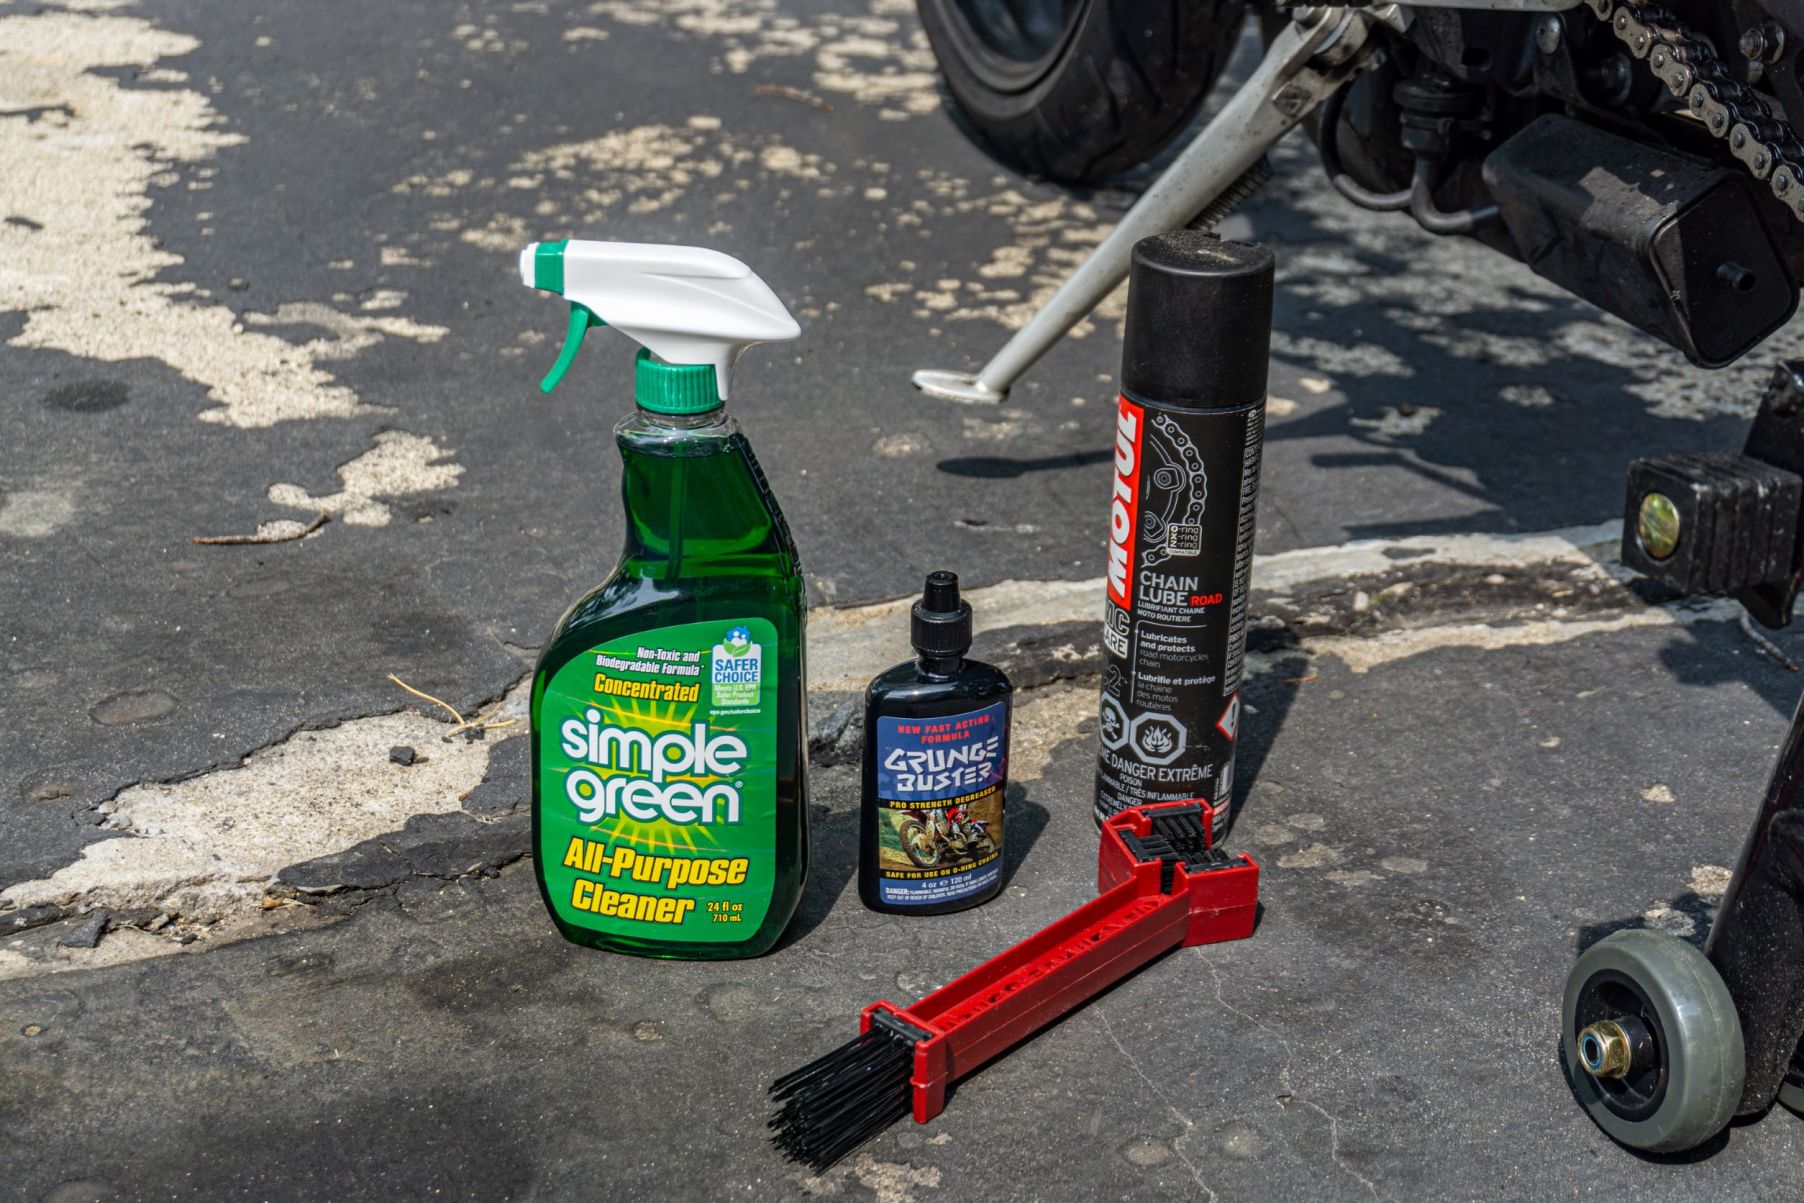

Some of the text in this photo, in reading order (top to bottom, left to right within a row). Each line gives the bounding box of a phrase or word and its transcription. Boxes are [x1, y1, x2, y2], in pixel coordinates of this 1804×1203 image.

[1107, 410, 1137, 598] MOTUL
[1170, 533, 1198, 541] X-ring
[1171, 525, 1199, 535] O-ring
[1170, 540, 1197, 549] Z-ring
[1140, 571, 1198, 591] CHAIN
[1139, 585, 1222, 606] LUBE ROAD
[1137, 601, 1178, 614] LUBRIFIANT
[1137, 609, 1156, 618] MOTO
[1104, 626, 1127, 657] ARE
[1141, 630, 1187, 644] Lubricates
[637, 646, 700, 662] Non-Toxic and
[1140, 640, 1196, 653] and protects
[1140, 650, 1158, 659] road
[596, 655, 659, 674] Biodegradable
[715, 659, 758, 672] SAFER
[1140, 658, 1160, 668] chain
[714, 671, 758, 683] CHOICE
[1138, 672, 1216, 687] Lubrifie et protège
[594, 673, 699, 702] Concentrated
[1152, 693, 1179, 703] motos
[898, 715, 990, 734] NEW FAST ACTING
[921, 731, 970, 744] FORMULA
[562, 709, 748, 783] simple
[884, 735, 999, 774] GRUNGE
[1111, 753, 1155, 780] DANGER
[1158, 763, 1213, 782] EXTRÊME
[896, 762, 993, 791] BUSTER
[1120, 772, 1142, 787] POISON
[890, 786, 996, 809] PRO STRENGTH DEGREASER
[563, 836, 749, 890] All-Purpose
[924, 870, 938, 878] USE
[940, 868, 951, 876] ON
[953, 862, 977, 873] O-RING
[951, 876, 962, 884] 120
[571, 878, 696, 924] Cleaner
[707, 901, 742, 912] 24 fl oz
[713, 913, 728, 922] 710
